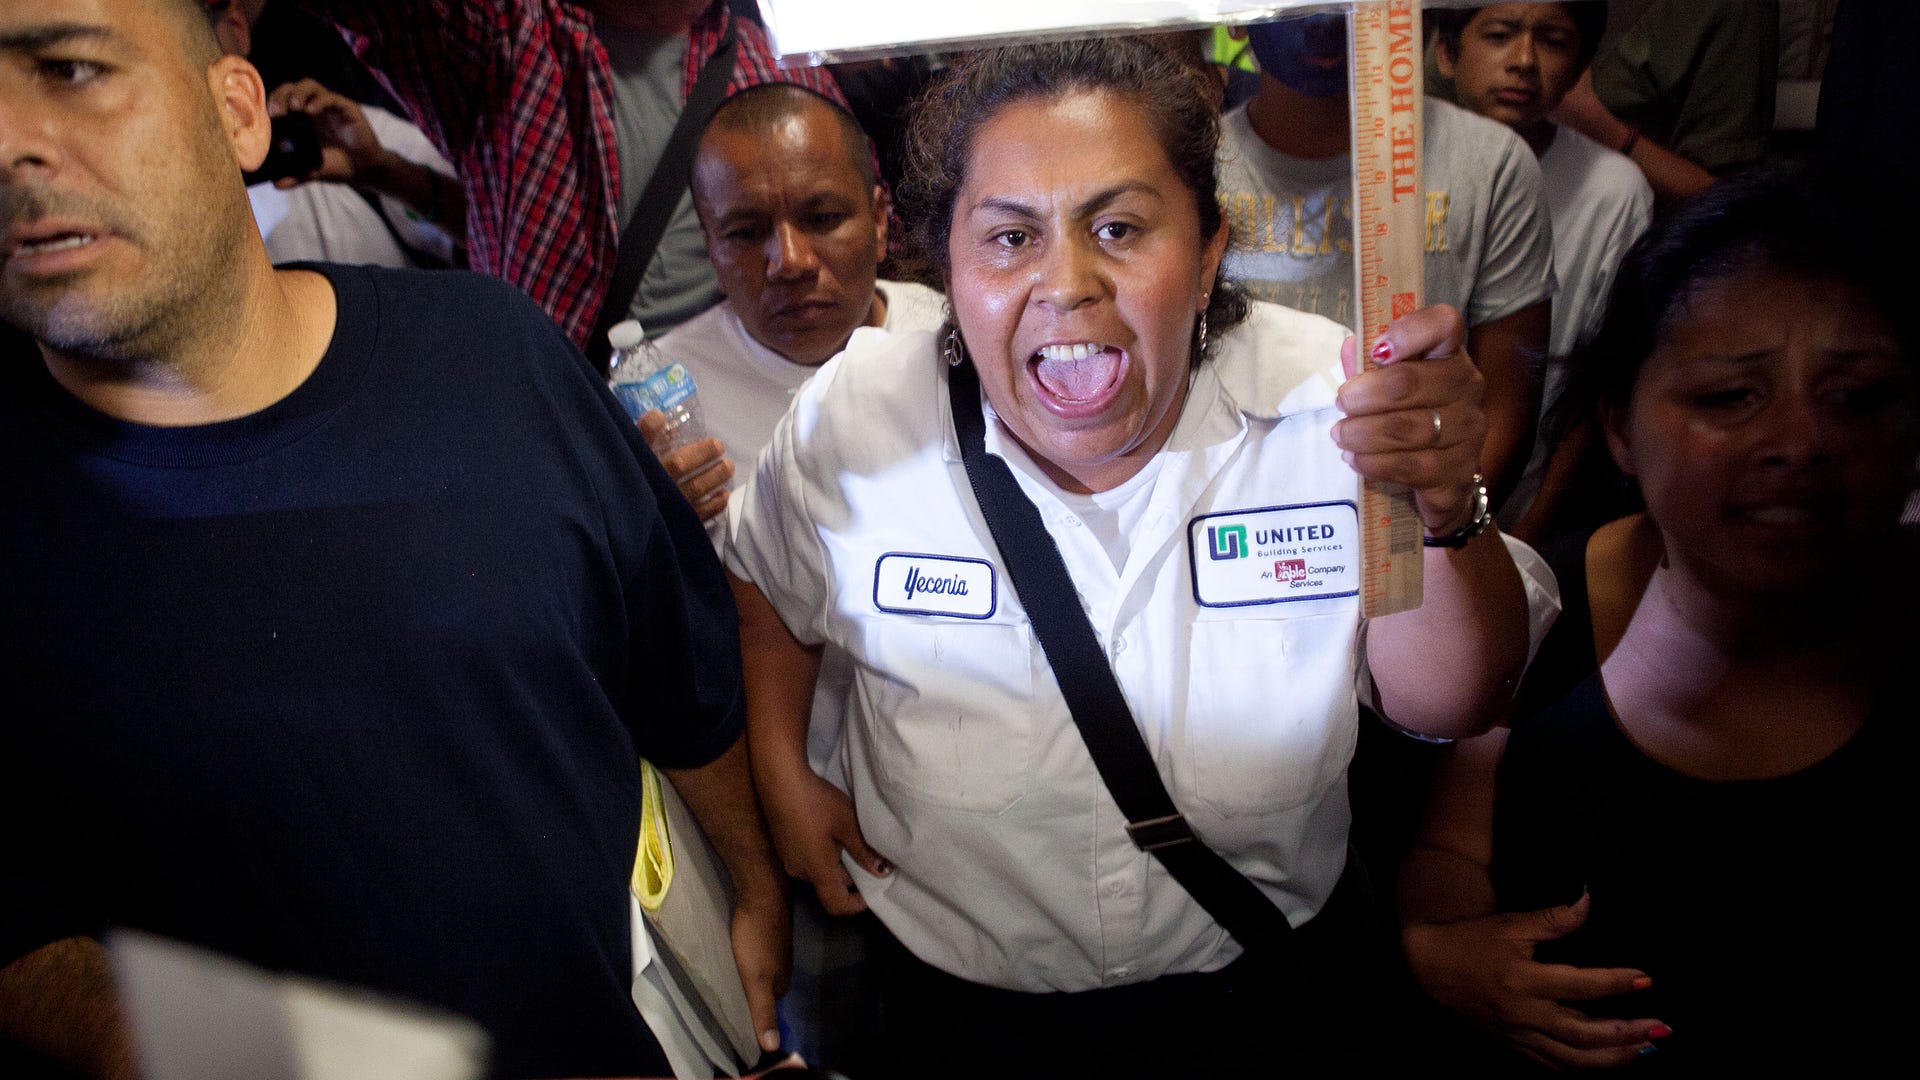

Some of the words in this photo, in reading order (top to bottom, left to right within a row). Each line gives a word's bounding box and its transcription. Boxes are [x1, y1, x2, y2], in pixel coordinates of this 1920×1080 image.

[1387, 0, 1415, 113] HOME
[1371, 65, 1384, 84] 11
[1374, 117, 1387, 139] 10
[1391, 123, 1416, 203] THE
[1375, 170, 1387, 184] 9
[1376, 222, 1389, 235] 8
[1255, 523, 1336, 546] UNITED
[1257, 546, 1298, 558] Building
[1301, 542, 1344, 554] Services
[1260, 570, 1273, 580] An
[1307, 563, 1346, 576] Company
[904, 565, 969, 600] Yecenia
[1289, 579, 1324, 589] Services
